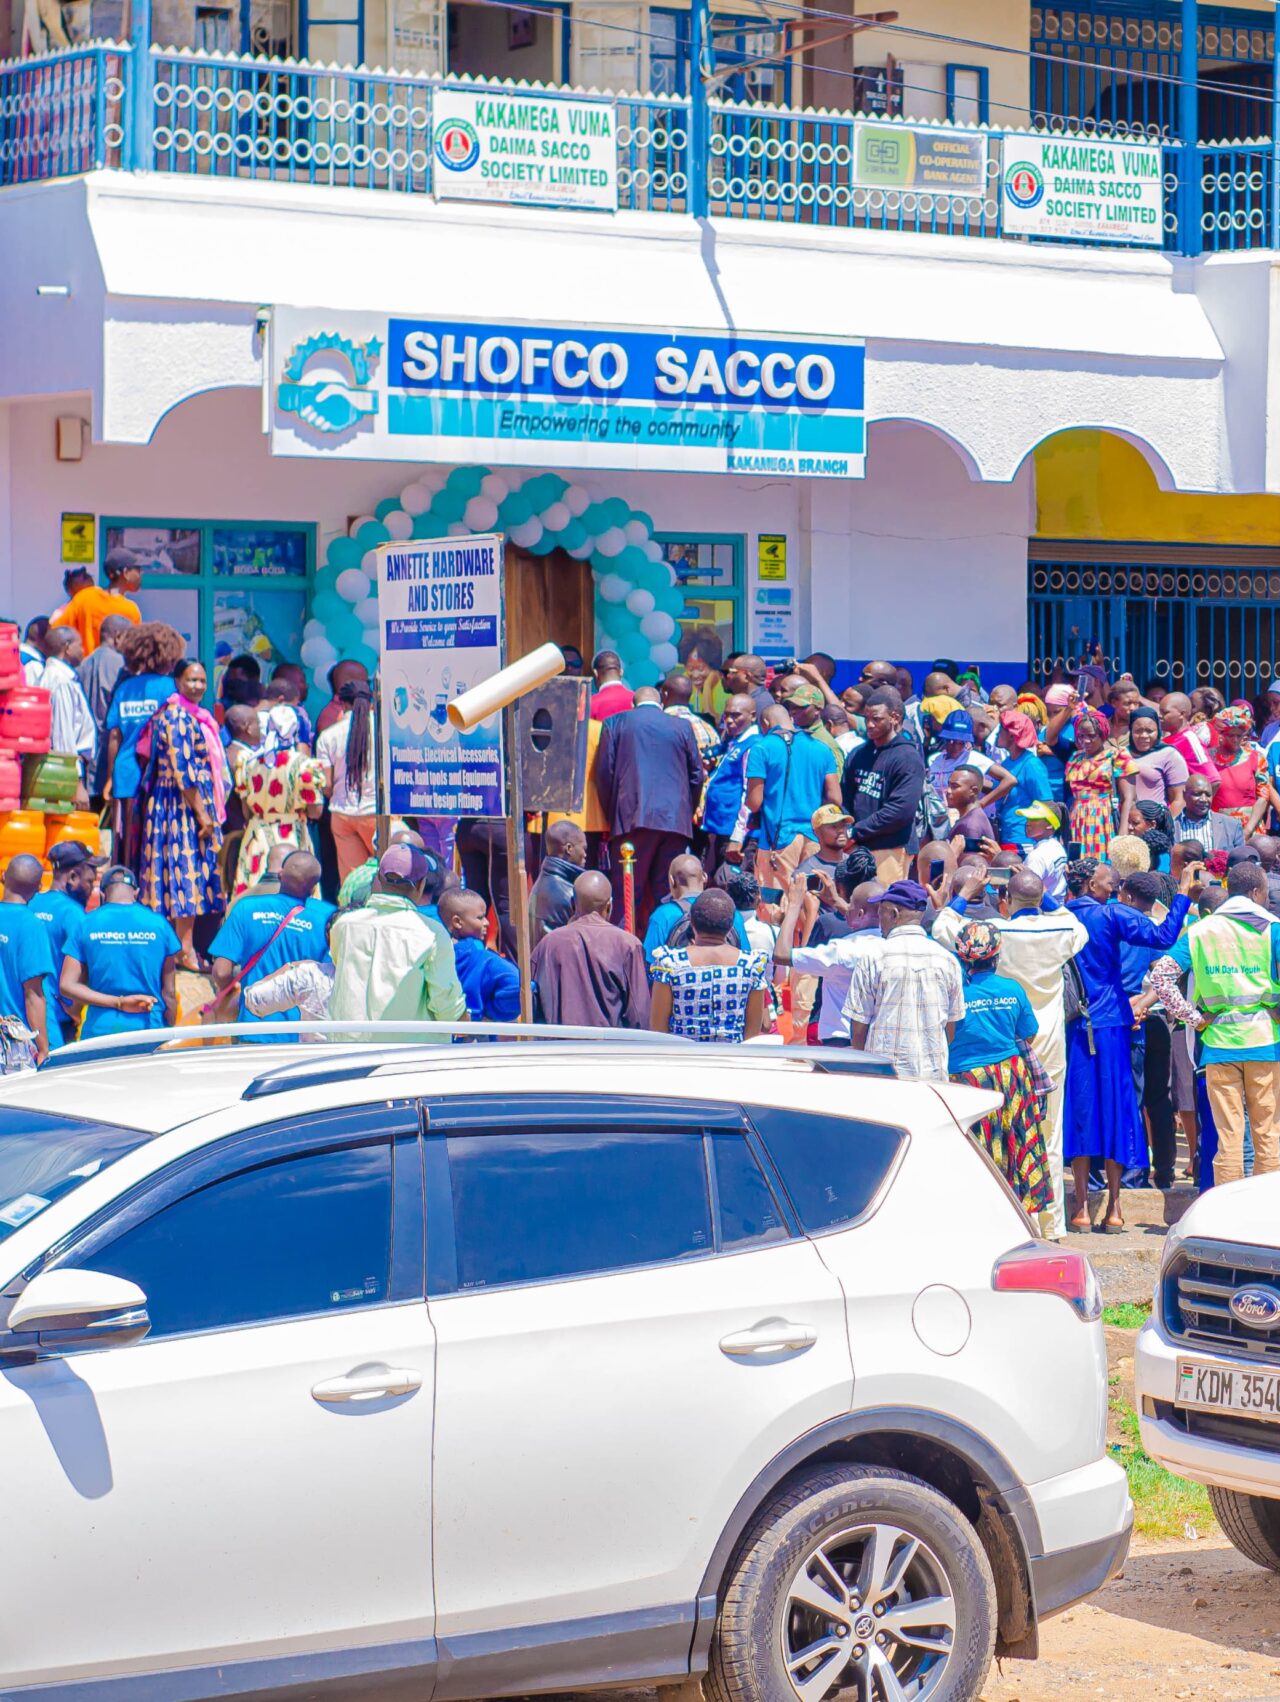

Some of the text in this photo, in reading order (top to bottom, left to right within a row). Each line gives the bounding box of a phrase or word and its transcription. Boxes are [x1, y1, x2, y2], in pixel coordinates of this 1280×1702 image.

[475, 100, 611, 137] KAKAMEGA VUMA
[489, 136, 591, 160] DAIMA SACCO
[932, 142, 971, 155] OFFICIAL
[919, 155, 980, 169] CO-OPERATIVE
[1041, 144, 1159, 178] KAKAMEGA VUMA
[481, 160, 545, 182] SOCIETY
[550, 166, 608, 187] LIMITED
[923, 170, 978, 184] BANK AGENT
[1053, 176, 1142, 199] DAIMA SACCO
[1046, 199, 1103, 220] SOCIETY
[1106, 204, 1157, 224] LIMITED
[402, 331, 836, 400] SHOFCO SACCO
[500, 409, 741, 442] Empowering the community
[727, 454, 848, 474] KAKAMEGA BRANCH
[386, 547, 494, 581] ANNETTE HARDWARE
[408, 582, 474, 612] AND STORES
[458, 618, 491, 634] Satisfaction
[90, 932, 156, 940] SHOFCO SACCO
[1205, 966, 1219, 974] SUN
[1238, 1294, 1267, 1316] Ford
[1196, 1369, 1232, 1406] KDM
